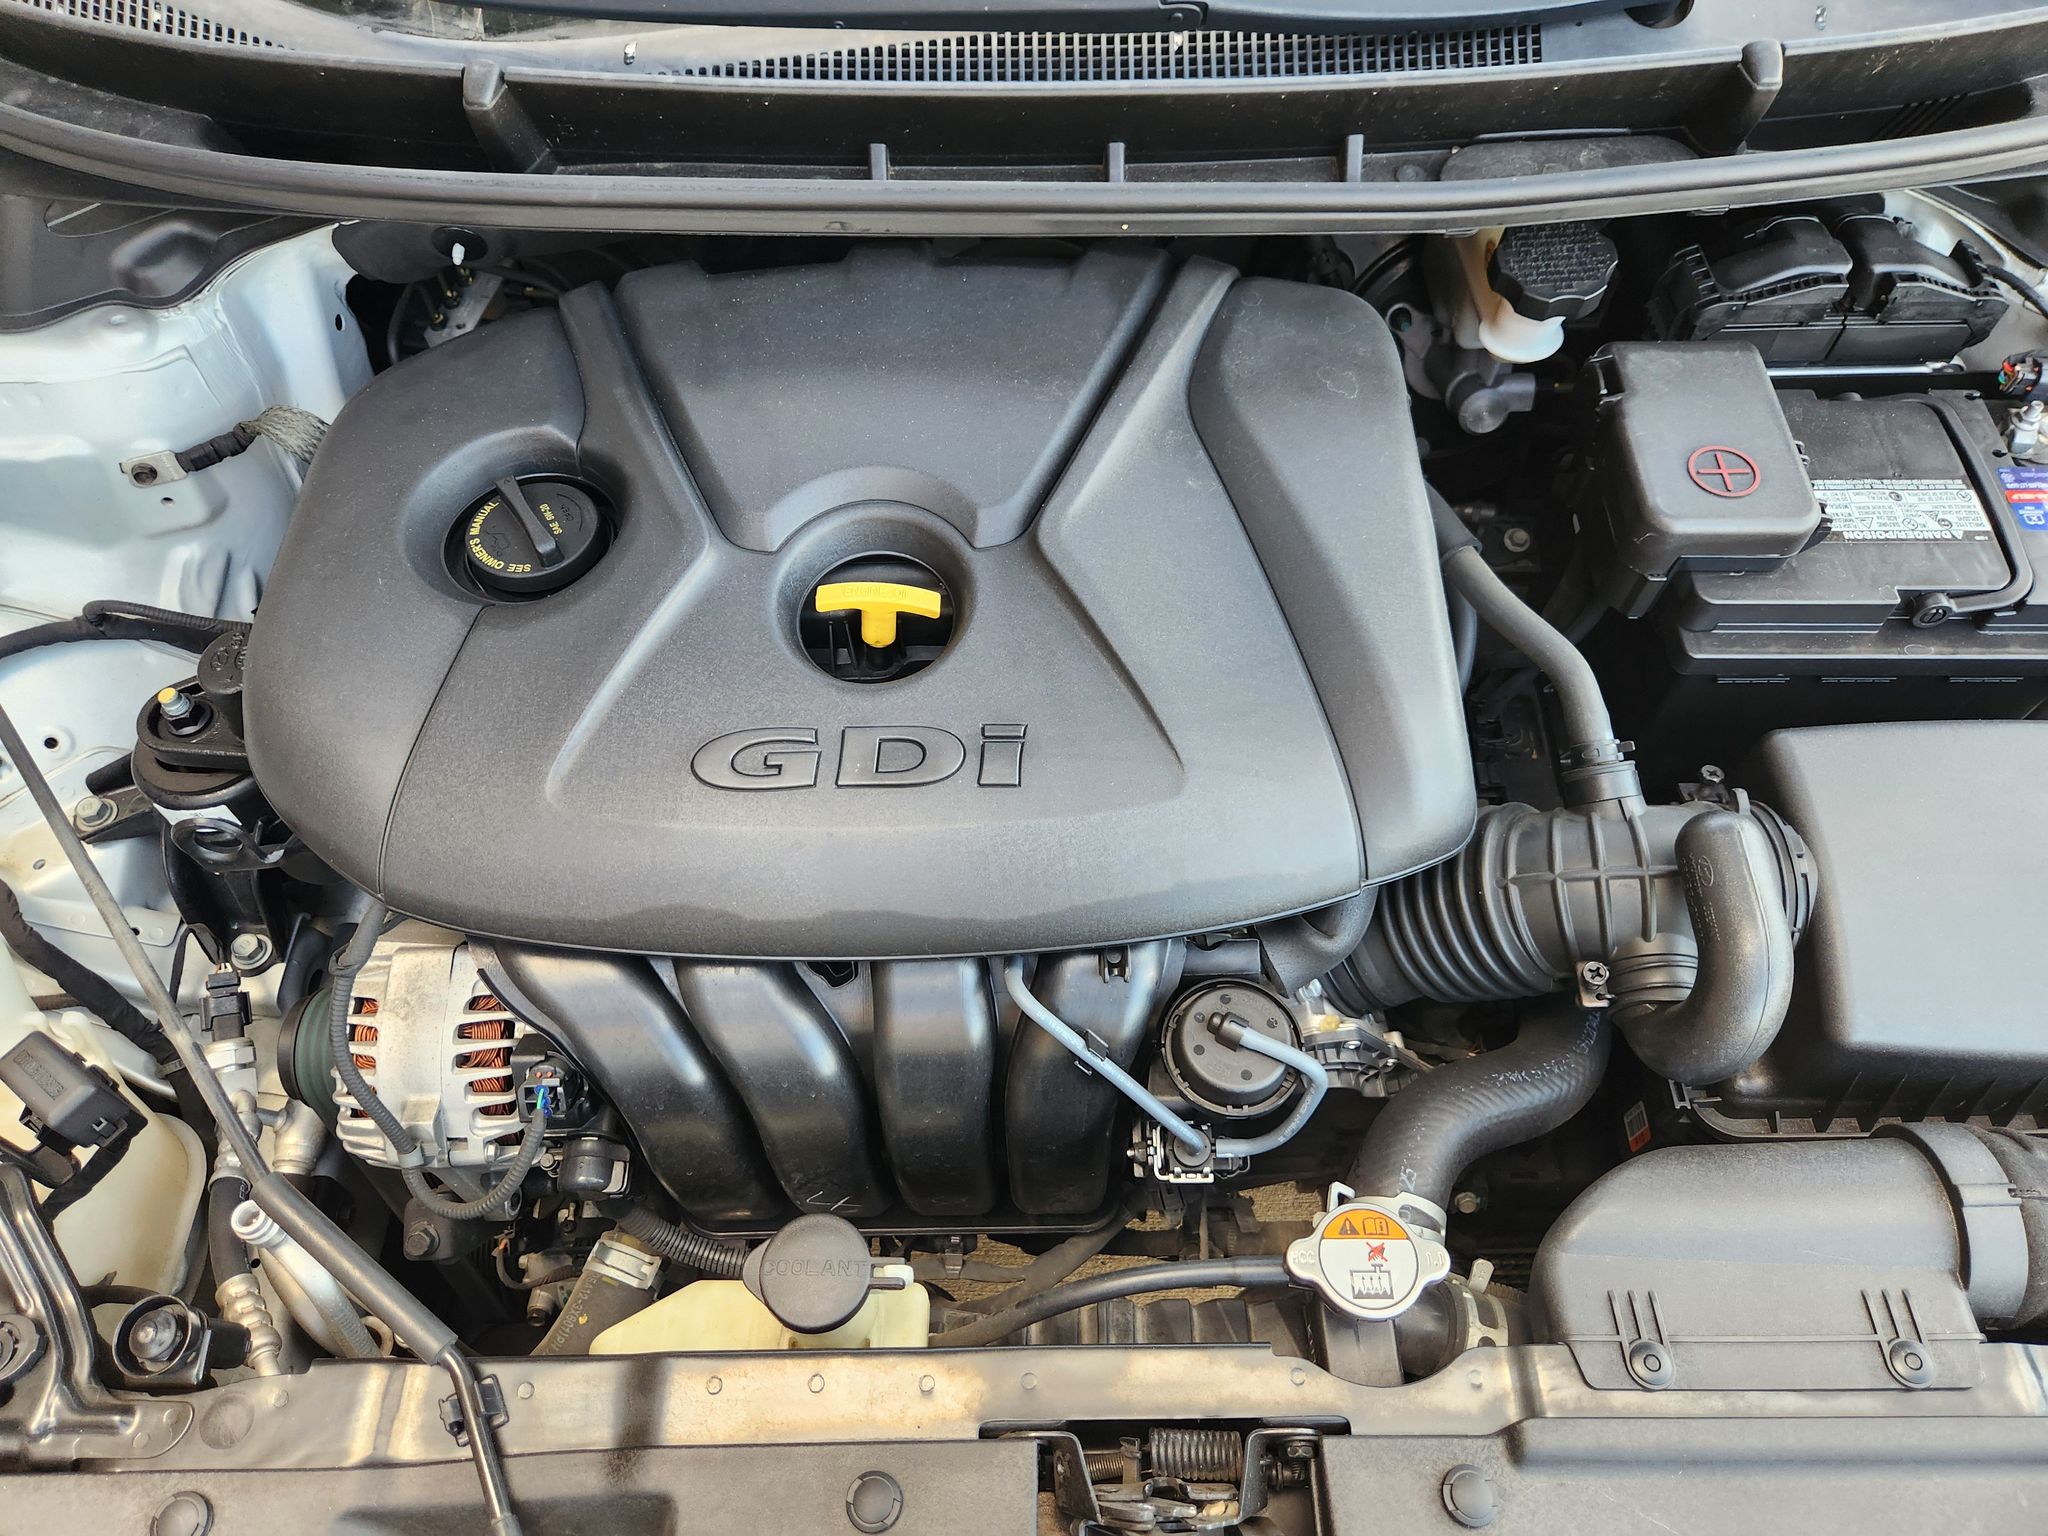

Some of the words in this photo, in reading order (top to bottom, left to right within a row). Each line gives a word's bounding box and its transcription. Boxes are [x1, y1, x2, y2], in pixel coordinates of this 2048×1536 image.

[469, 500, 500, 536] MANUAL
[549, 521, 563, 535] SAE
[1843, 530, 1952, 540] DANGER/POISON
[469, 538, 505, 570] OWNER'S
[507, 563, 532, 573] SEE
[690, 723, 1028, 791] GDi
[765, 1259, 868, 1277] COOLANT
